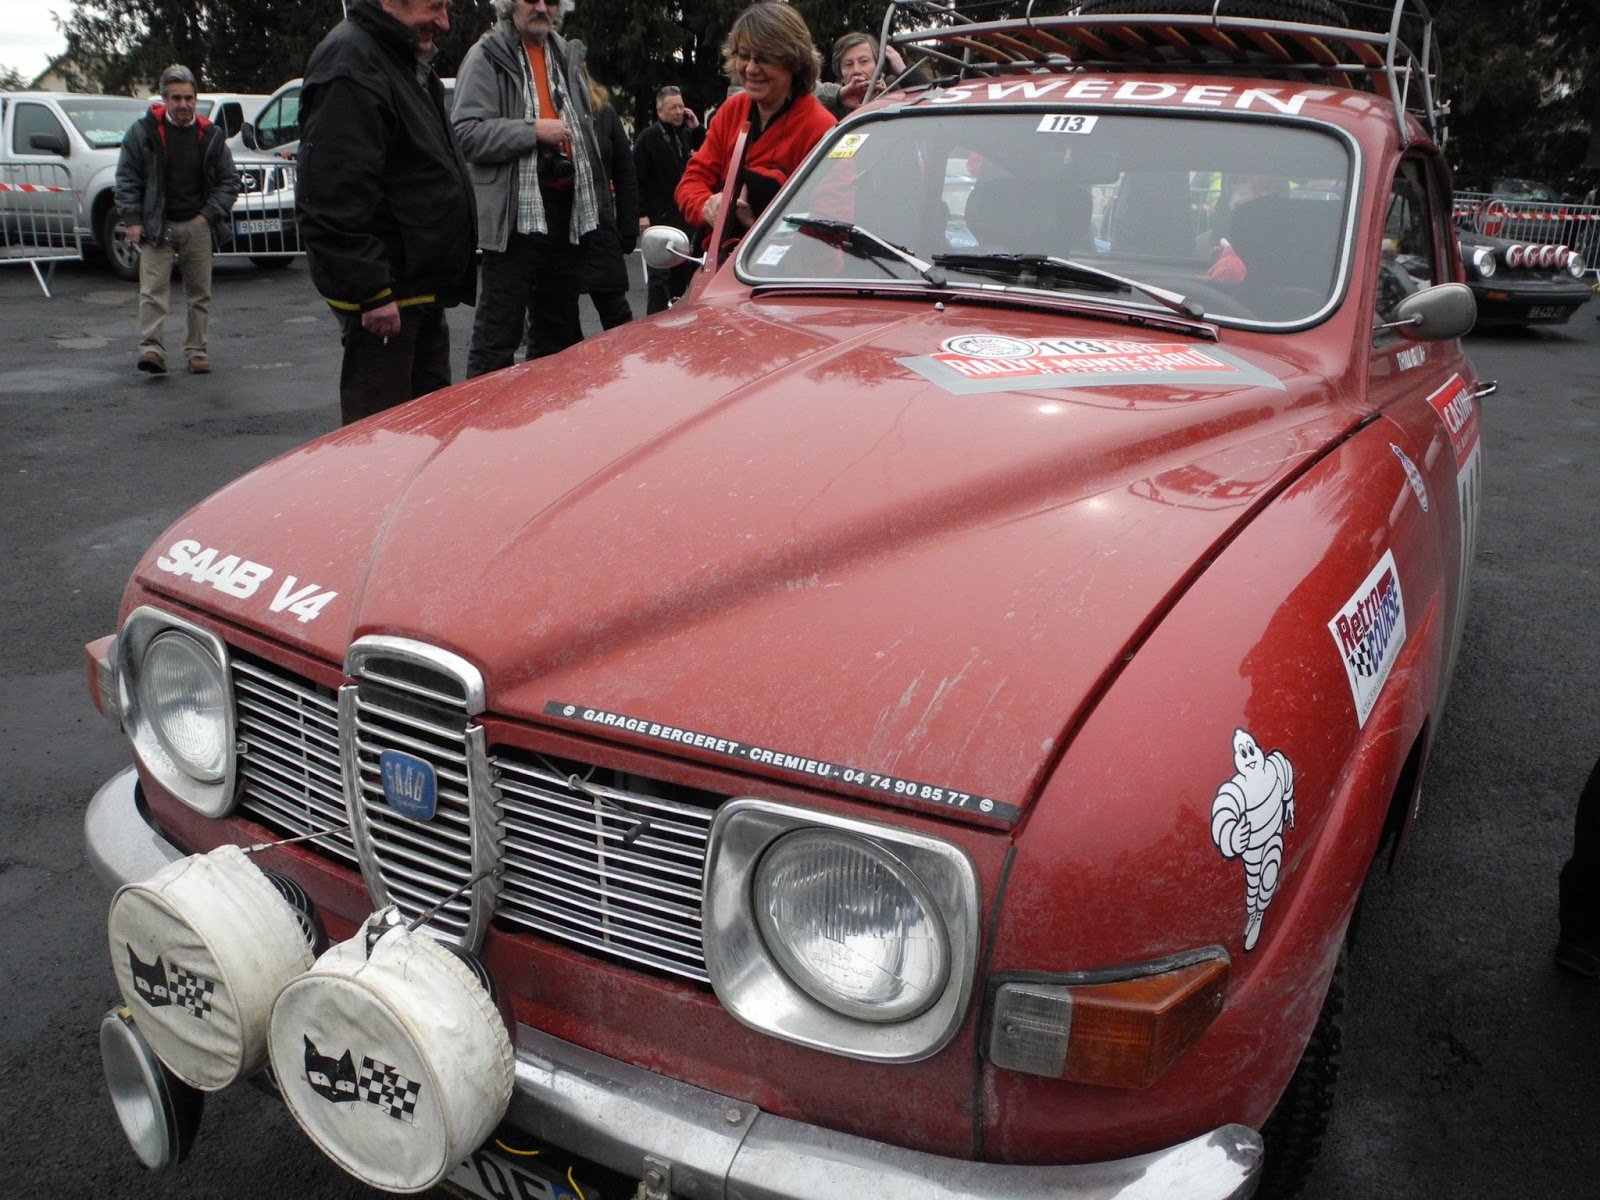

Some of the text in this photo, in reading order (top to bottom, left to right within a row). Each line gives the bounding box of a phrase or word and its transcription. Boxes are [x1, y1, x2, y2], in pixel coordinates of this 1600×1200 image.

[931, 81, 1308, 114] SWEDEN
[1049, 115, 1085, 132] 113
[942, 350, 1224, 375] RALLYE MONTE-CARLO
[1039, 341, 1107, 354] 113
[157, 539, 339, 623] SAAB V4
[1335, 586, 1381, 660] Retro
[1367, 576, 1400, 674] COURSE
[583, 709, 649, 733] GARAGE
[649, 724, 739, 754] BERGERET
[749, 747, 831, 776] CREMIEU
[842, 769, 865, 784] 04
[870, 774, 890, 790] 74
[894, 780, 918, 796] 90
[919, 785, 943, 801] 85
[947, 791, 970, 807] 77
[385, 761, 425, 802] SAAB
